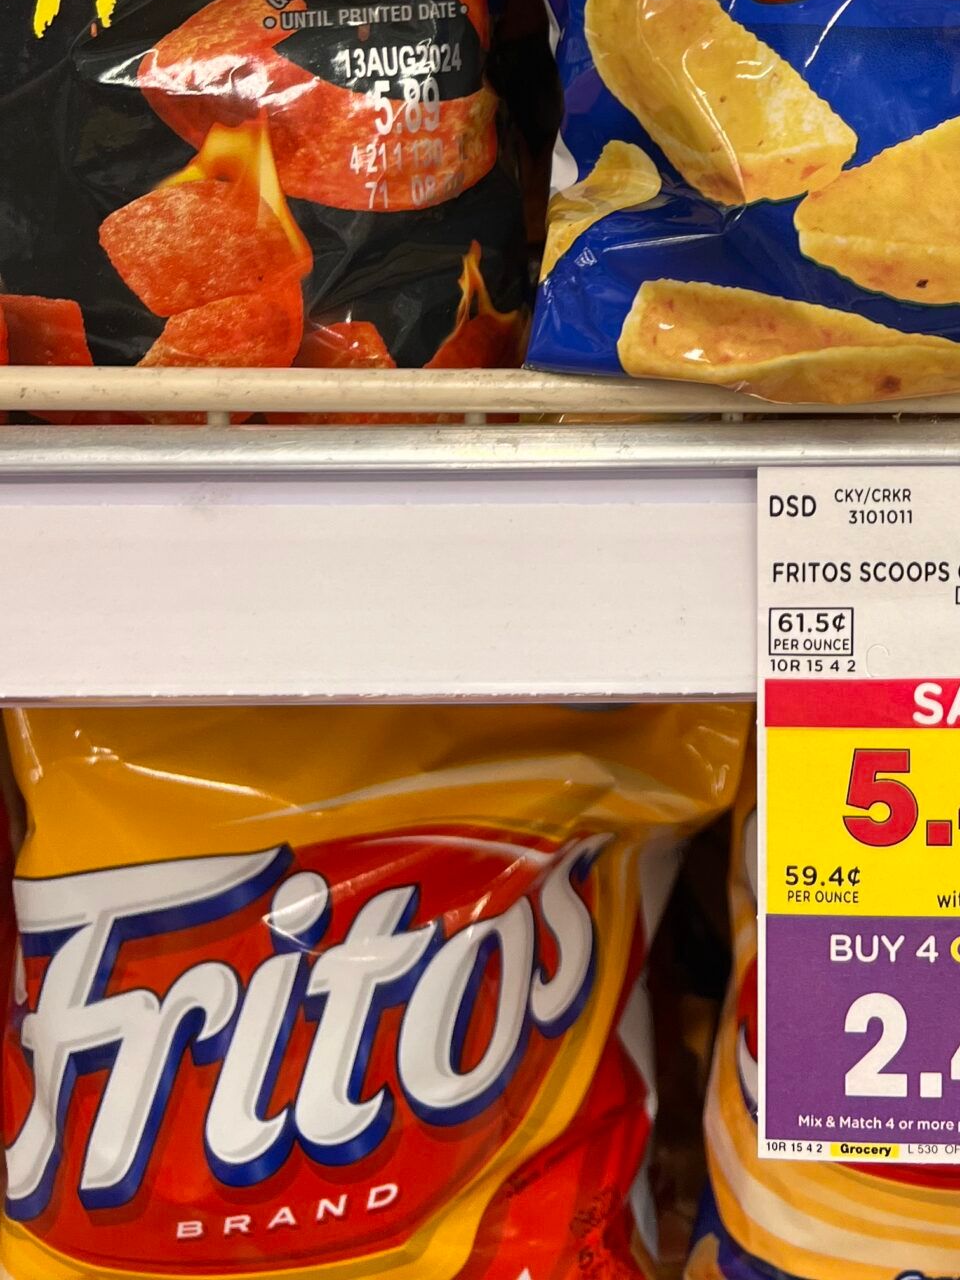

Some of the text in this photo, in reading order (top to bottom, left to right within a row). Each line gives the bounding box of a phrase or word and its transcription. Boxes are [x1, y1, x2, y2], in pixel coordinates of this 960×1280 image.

[280, 1, 456, 30] UNTIL PRINTED DATE
[343, 42, 462, 78] 13AUG2024
[374, 77, 441, 136] 5.89
[769, 495, 817, 518] DSD
[834, 488, 912, 504] CKY/CRKR
[848, 510, 913, 524] 3101011
[772, 562, 852, 582] FRITOS
[859, 562, 950, 582] SCOOPS
[777, 612, 847, 634] 61.5¢
[773, 638, 850, 651] PER OUNCE
[806, 659, 823, 673] 15
[830, 659, 840, 673] 4
[846, 659, 856, 673] 2
[785, 865, 861, 887] 59.4¢
[787, 890, 859, 904] PER OUNCE
[829, 934, 905, 963] BUY
[916, 934, 939, 963] 4
[3, 831, 615, 1221] Fritos
[798, 1115, 823, 1128] Mix
[826, 1116, 836, 1128] &
[839, 1115, 882, 1129] Match
[885, 1117, 895, 1129] 4
[898, 1120, 915, 1131] or
[917, 1120, 955, 1131] more
[791, 1143, 803, 1153] 15
[806, 1143, 813, 1153] 4
[816, 1143, 823, 1153] 2
[840, 1144, 892, 1157] Grocery
[908, 1145, 915, 1154] L
[917, 1145, 938, 1154] 530
[945, 1145, 960, 1155] OF
[175, 1183, 399, 1239] BRAND
